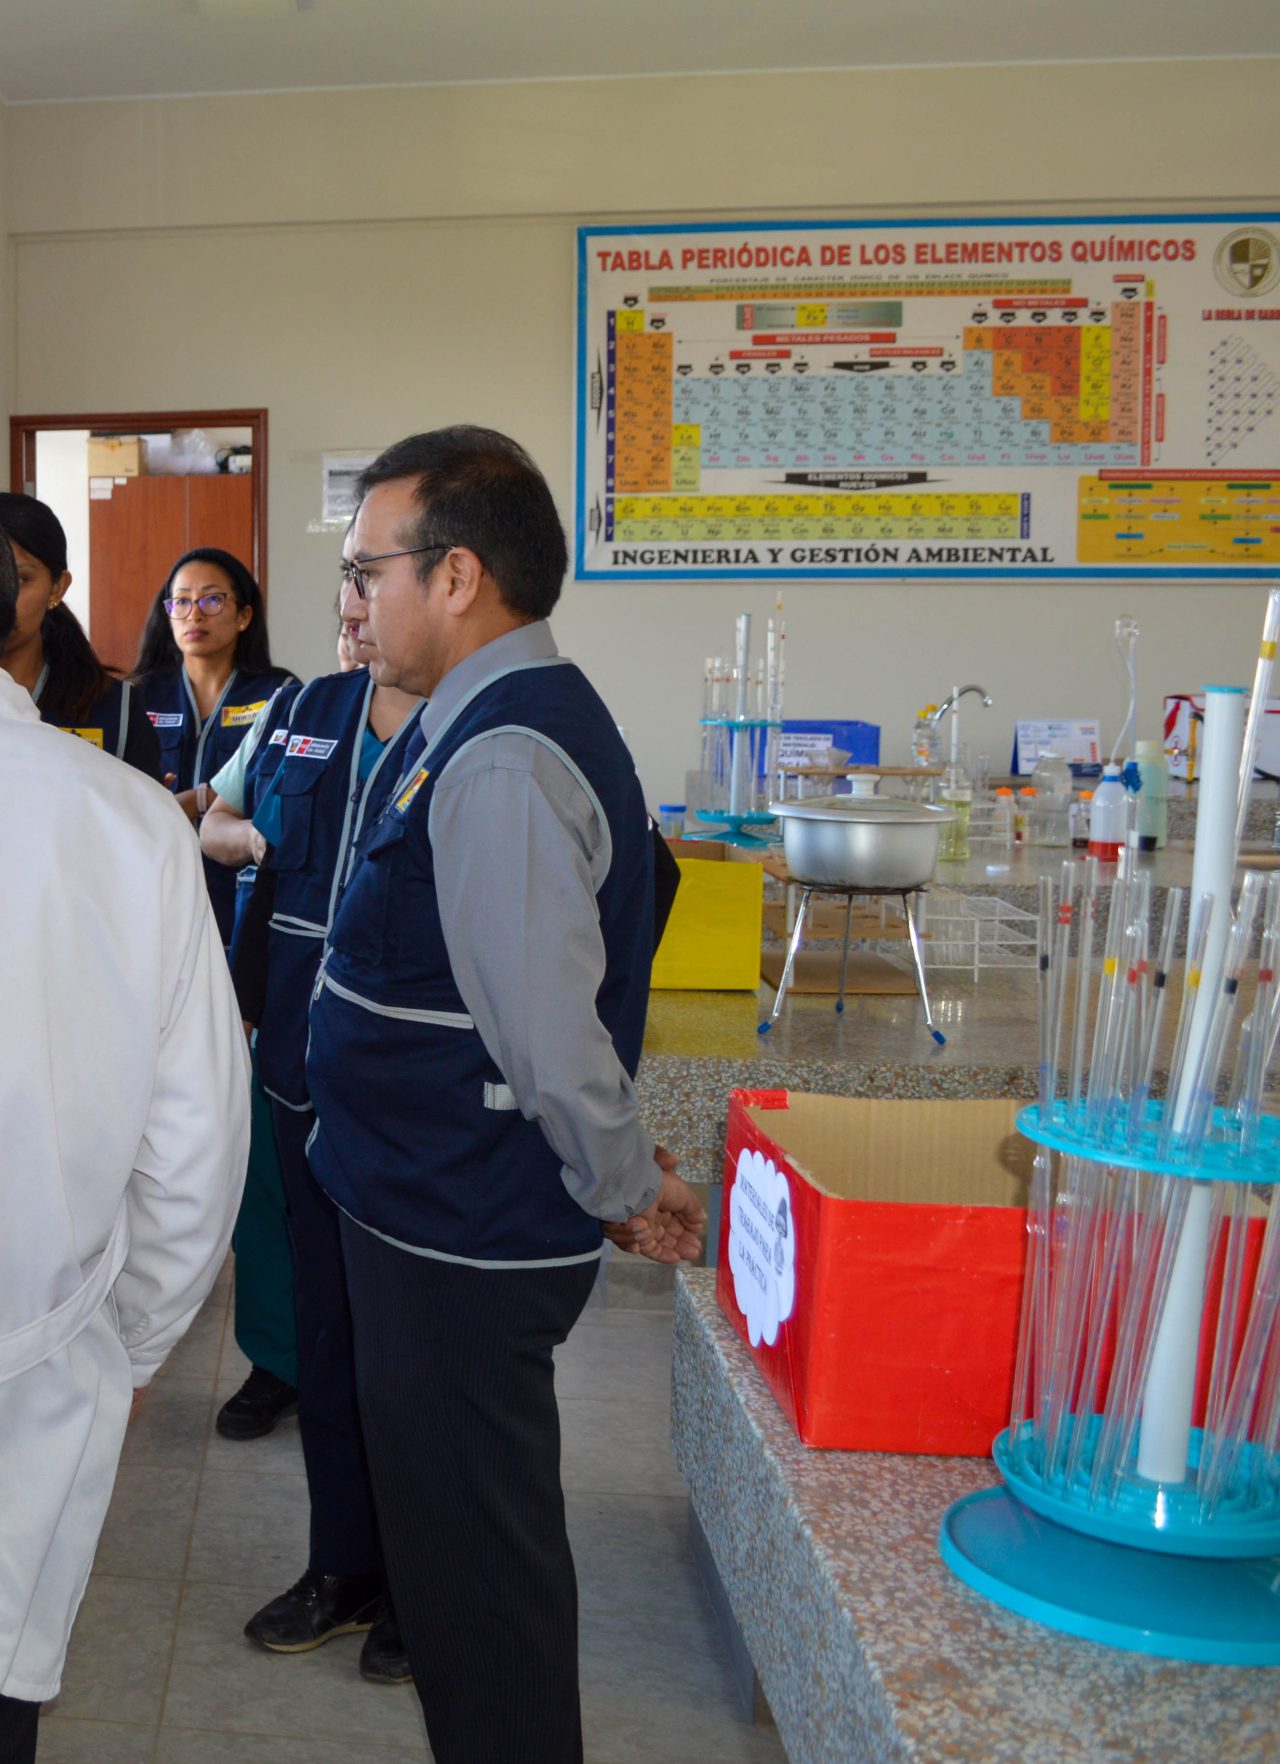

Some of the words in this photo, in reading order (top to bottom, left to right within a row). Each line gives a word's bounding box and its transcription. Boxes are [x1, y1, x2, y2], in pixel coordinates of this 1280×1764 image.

[597, 249, 673, 272] TABLA
[681, 242, 812, 269] PERIÓDICA
[820, 245, 851, 266] DE
[859, 244, 906, 265] LOS
[915, 239, 1063, 264] ELEMENTOS
[1072, 236, 1196, 264] QUÍMICOS
[612, 548, 760, 566] INGENIERIA
[768, 547, 788, 564] Y
[790, 543, 899, 564] GESTIÓN
[908, 547, 1054, 564] AMBIENTAL
